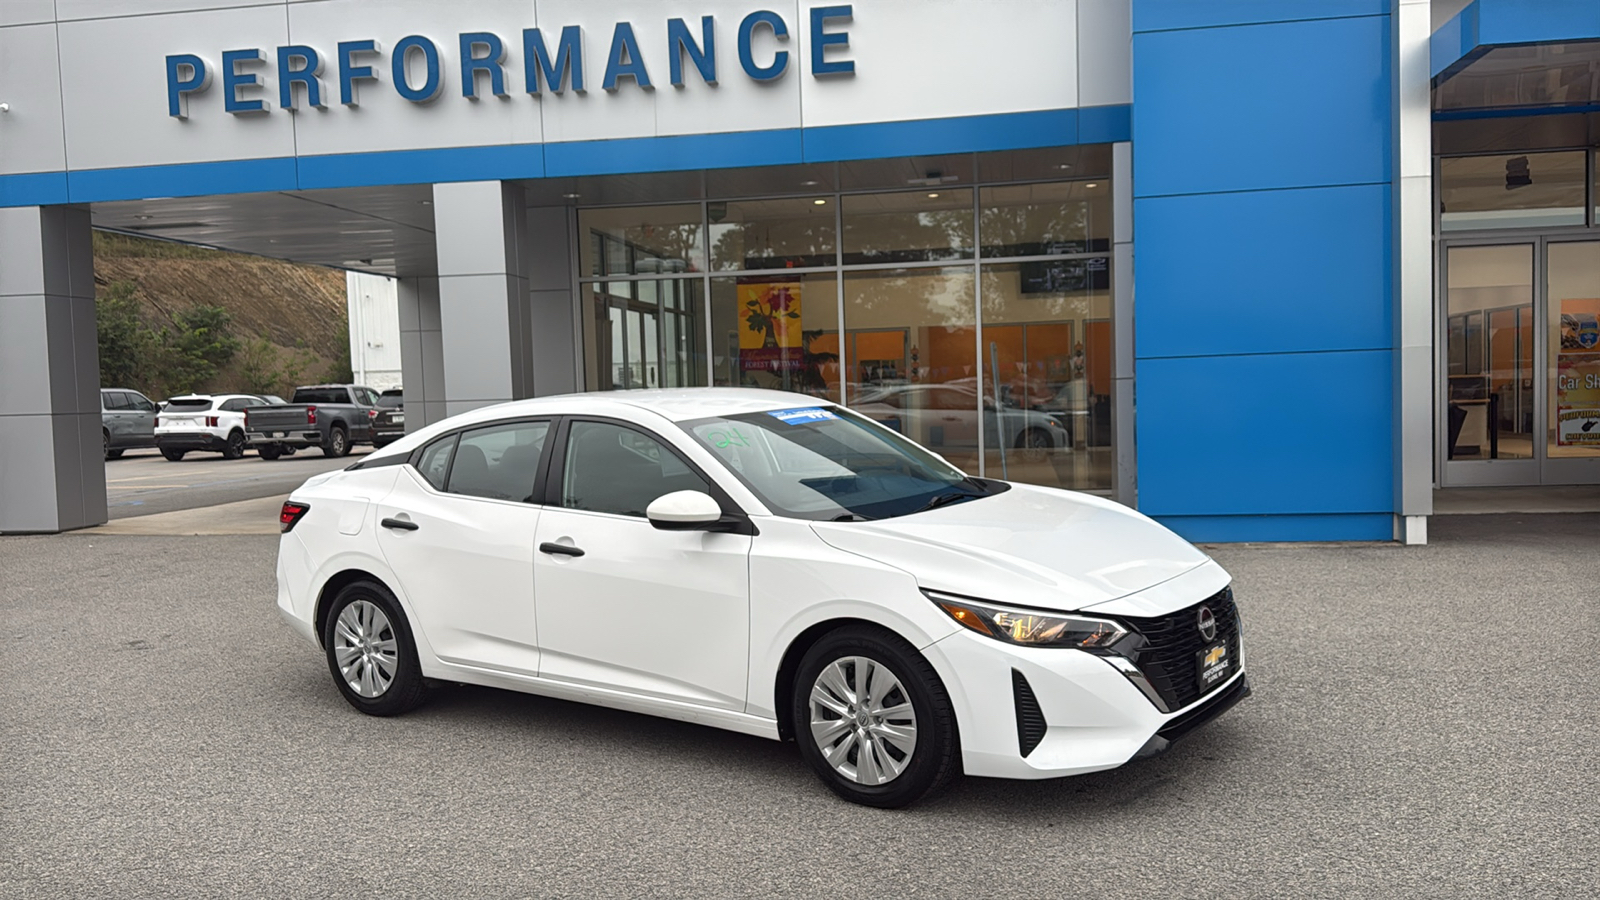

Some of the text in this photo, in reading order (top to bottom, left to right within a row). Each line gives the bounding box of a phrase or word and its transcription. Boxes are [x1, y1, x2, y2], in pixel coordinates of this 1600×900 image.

[165, 5, 855, 119] PERFORMANCE
[770, 359, 800, 368] FSTIVAL
[1558, 374, 1581, 389] Car
[707, 427, 751, 449] 24
